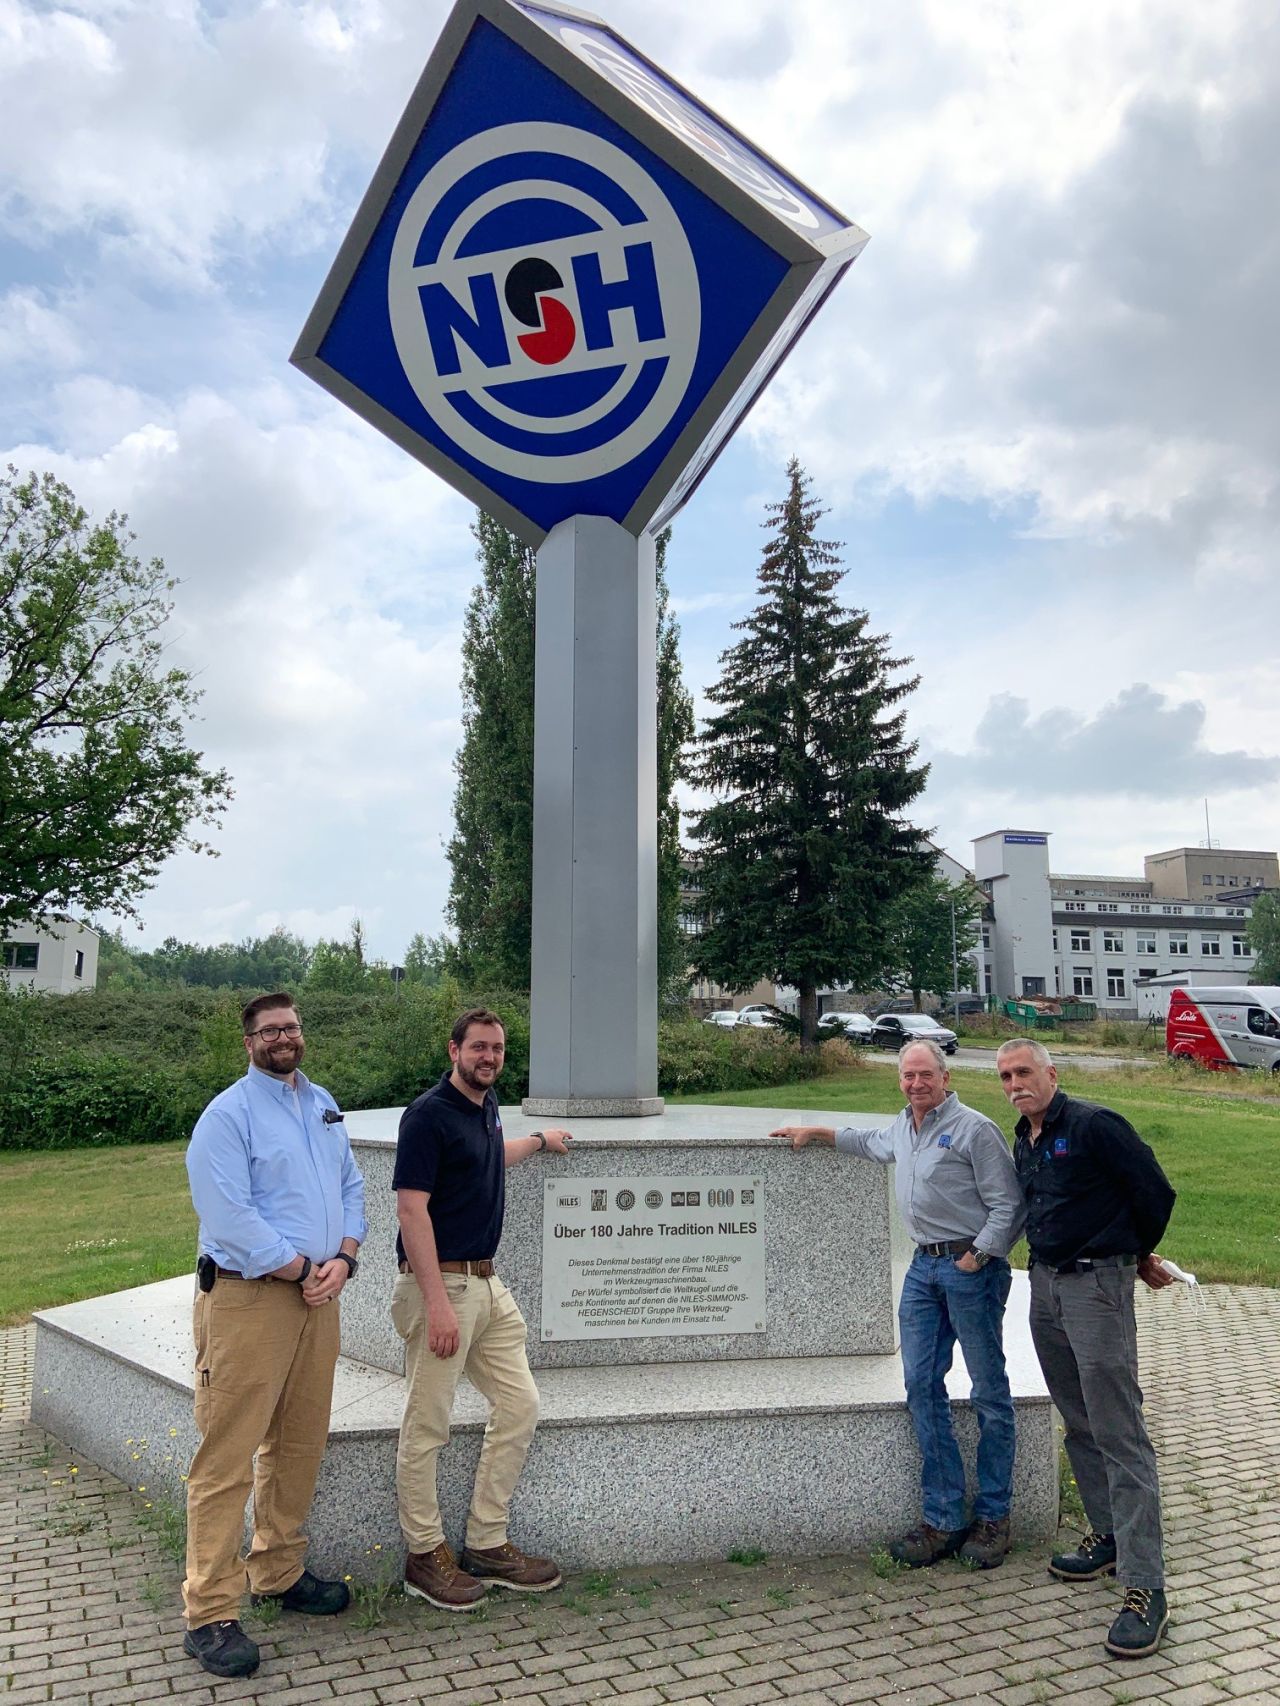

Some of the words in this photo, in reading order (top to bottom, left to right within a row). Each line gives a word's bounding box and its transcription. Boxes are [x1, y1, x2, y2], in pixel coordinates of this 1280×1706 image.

[418, 241, 666, 377] NSH
[1175, 1010, 1197, 1021] Linde
[559, 1197, 578, 1206] NILES
[554, 1223, 586, 1238] Über
[590, 1225, 613, 1238] 180
[617, 1224, 654, 1237] Jahre
[658, 1223, 714, 1236] Tradition
[718, 1221, 757, 1235] NILES
[568, 1259, 595, 1267] Dieses
[596, 1257, 630, 1266] Denkmal
[631, 1256, 663, 1266] bestätigt
[664, 1256, 680, 1264] eine
[682, 1255, 699, 1264] über
[702, 1255, 742, 1264] 180-jährige
[581, 1266, 666, 1276] Unternehmenstradition
[667, 1266, 681, 1274] der
[682, 1265, 703, 1273] Firma
[704, 1264, 729, 1273] NILES
[615, 1275, 707, 1286] Werkzeugmaschinenbau.
[571, 1289, 586, 1297] Der
[587, 1287, 612, 1296] Würfel
[614, 1286, 659, 1297] symbolisiert
[660, 1285, 671, 1294] die
[673, 1284, 710, 1294] Weltkugel
[711, 1284, 726, 1292] und
[726, 1283, 738, 1292] die
[560, 1299, 583, 1308] sechs
[585, 1298, 626, 1307] Kontinente
[627, 1296, 641, 1305] auf
[641, 1296, 665, 1305] denen
[666, 1295, 678, 1304] die
[680, 1293, 749, 1303] NILES-SIMMONS-
[578, 1306, 646, 1317] HEGENSCHEIDT
[647, 1306, 675, 1315] Gruppe
[676, 1305, 691, 1313] ihre
[692, 1304, 733, 1314] Werkzeug-
[584, 1318, 626, 1327] maschinen
[627, 1317, 639, 1325] bei
[640, 1316, 670, 1325] Kunden
[671, 1316, 681, 1324] im
[682, 1315, 710, 1324] Einsatz
[711, 1314, 726, 1322] hat.
